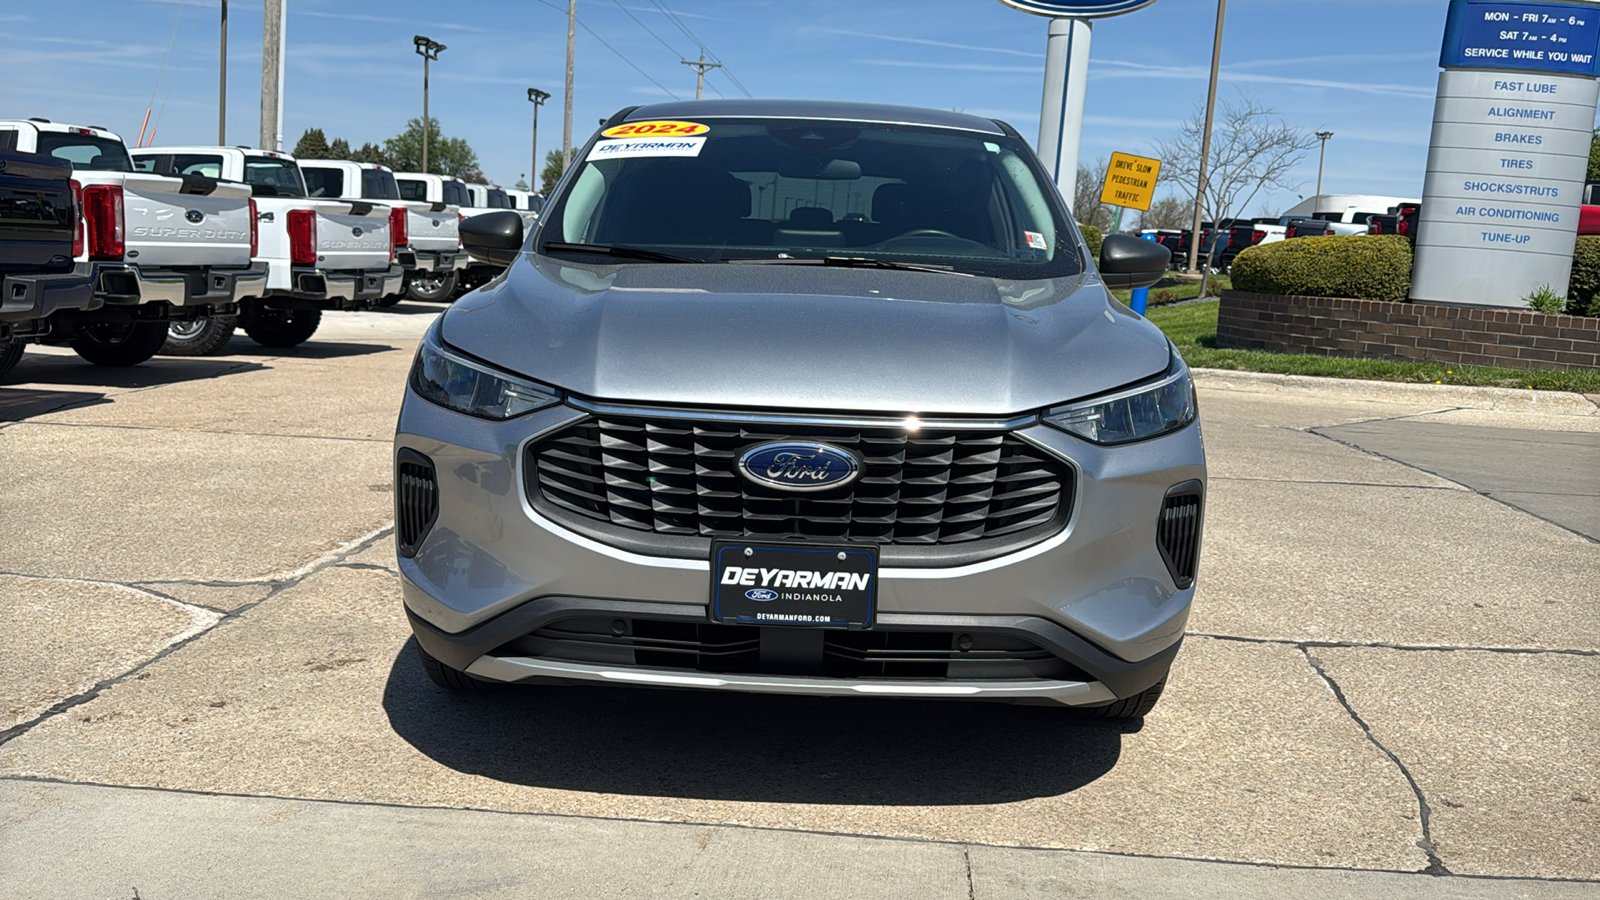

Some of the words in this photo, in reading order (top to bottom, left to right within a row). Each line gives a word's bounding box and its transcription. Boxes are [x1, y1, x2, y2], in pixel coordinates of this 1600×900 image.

[1484, 12, 1509, 22] MON
[1522, 13, 1538, 23] FRI
[1499, 30, 1519, 40] SAT
[1464, 47, 1509, 58] SERVICE
[1513, 49, 1544, 60] WHILE
[1548, 51, 1568, 62] YOU
[1571, 53, 1593, 64] WAIT
[1494, 81, 1524, 92] FAST
[1526, 83, 1557, 94] LUBE
[1487, 107, 1556, 120] ALIGNMENT
[610, 124, 700, 136] 2024
[1494, 132, 1543, 145] BRAKES
[599, 142, 698, 152] DEYARMAN
[1115, 160, 1134, 171] DRIVE
[1136, 163, 1152, 174] SLOW
[1500, 158, 1534, 169] TIRES
[1111, 174, 1149, 188] PEDESTRIAN
[1463, 181, 1559, 197] SHOCKS/STRUTS
[1115, 190, 1140, 202] TRAFFIC
[1455, 206, 1476, 216] AIR
[1478, 207, 1560, 222] CONDITIONING
[133, 226, 200, 238] SUPER
[204, 228, 246, 240] DUTY
[1481, 232, 1531, 244] TUNE-UP
[321, 241, 361, 249] SUPER
[766, 452, 831, 480] Ford
[720, 566, 870, 591] DEYARMAN
[751, 590, 771, 599] Ford
[781, 592, 842, 602] INDIANOLA
[756, 613, 831, 622] DEYARMANFORD.COM
